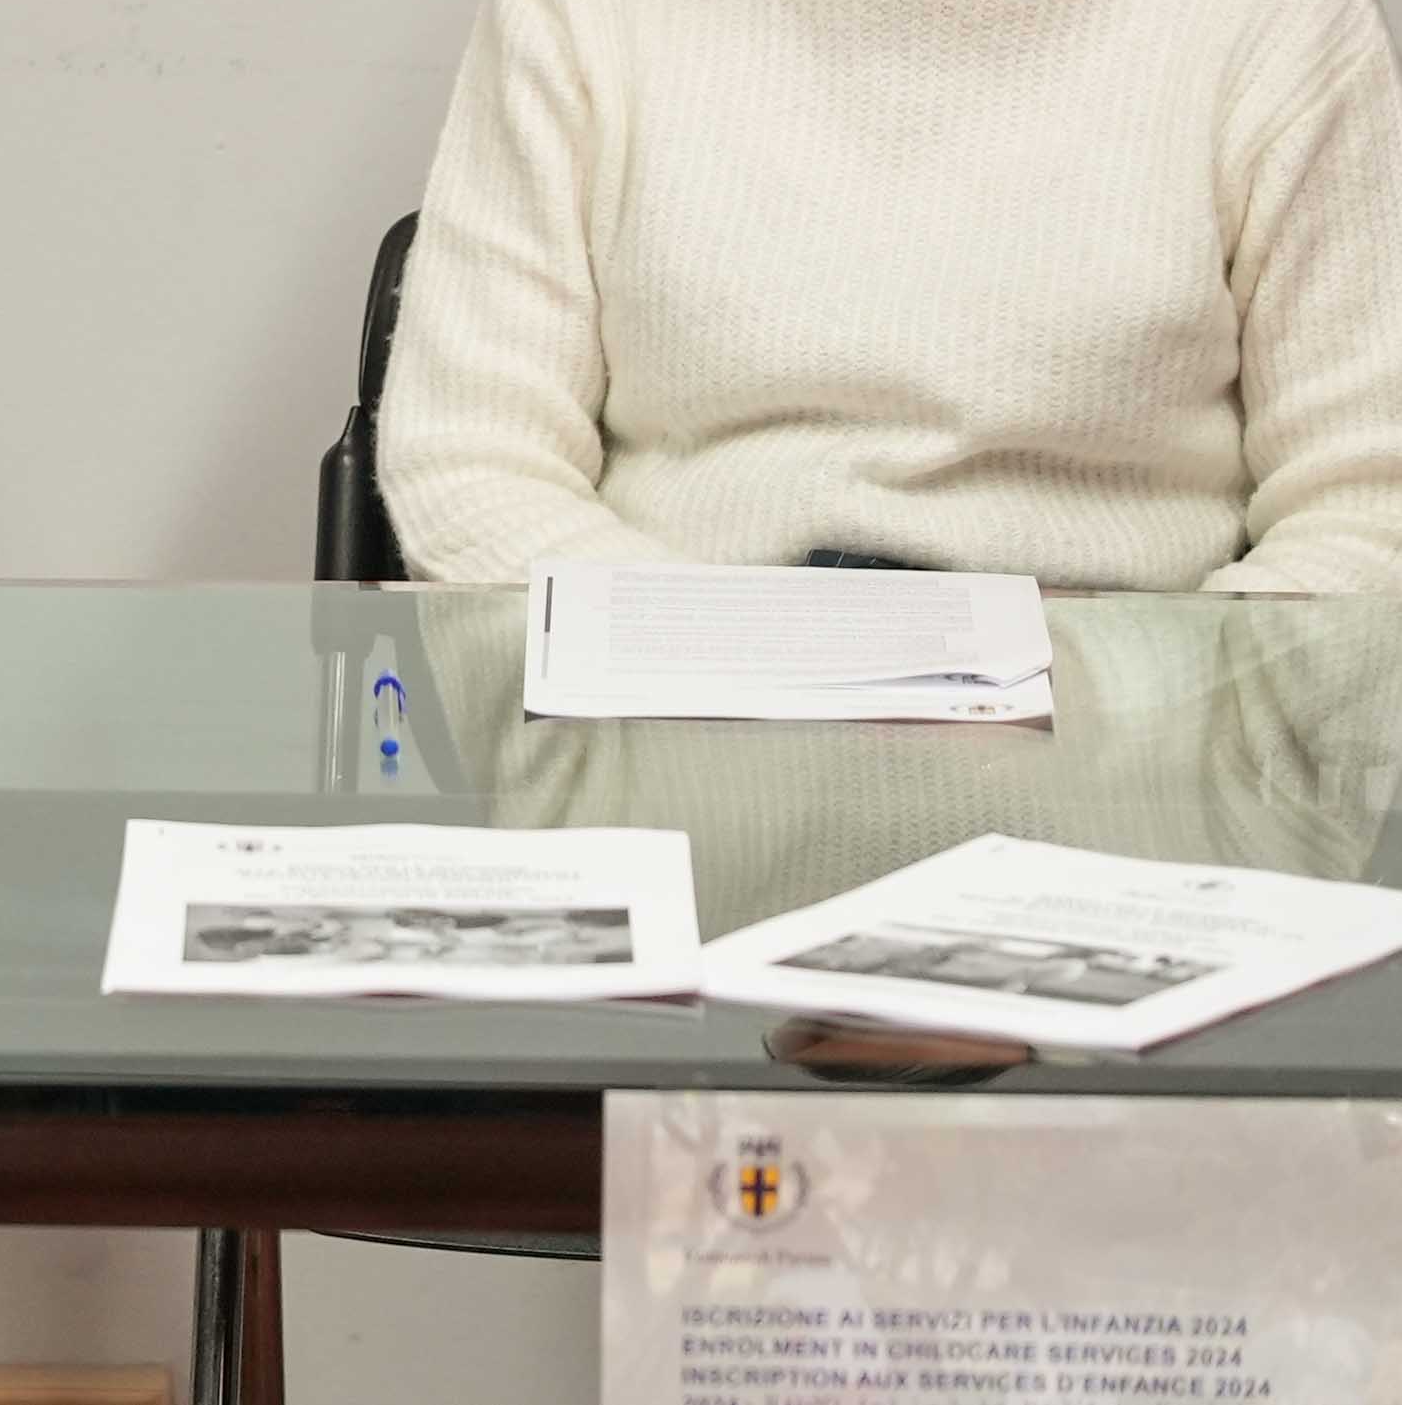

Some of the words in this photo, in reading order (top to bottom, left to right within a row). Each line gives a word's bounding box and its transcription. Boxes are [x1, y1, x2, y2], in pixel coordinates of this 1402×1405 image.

[681, 1306, 828, 1328] ISCRIZIONE
[840, 1307, 864, 1327] AI
[873, 1309, 972, 1330] SERVIZI
[980, 1312, 1032, 1332] PER
[1041, 1313, 1182, 1335] L'INFANZIA
[1192, 1315, 1247, 1336] 2024
[682, 1338, 844, 1359] ENROLMENT
[853, 1340, 879, 1359] IN
[887, 1341, 1037, 1363] CHILDCARE
[1047, 1344, 1177, 1366] SERVICES
[1187, 1346, 1243, 1367] 2024
[681, 1367, 847, 1389] INSCRIPTION
[858, 1369, 909, 1391] AUX
[918, 1371, 1046, 1394] SERVICES
[1056, 1374, 1204, 1396] D'ENFANCE
[1214, 1376, 1272, 1398] 2024
